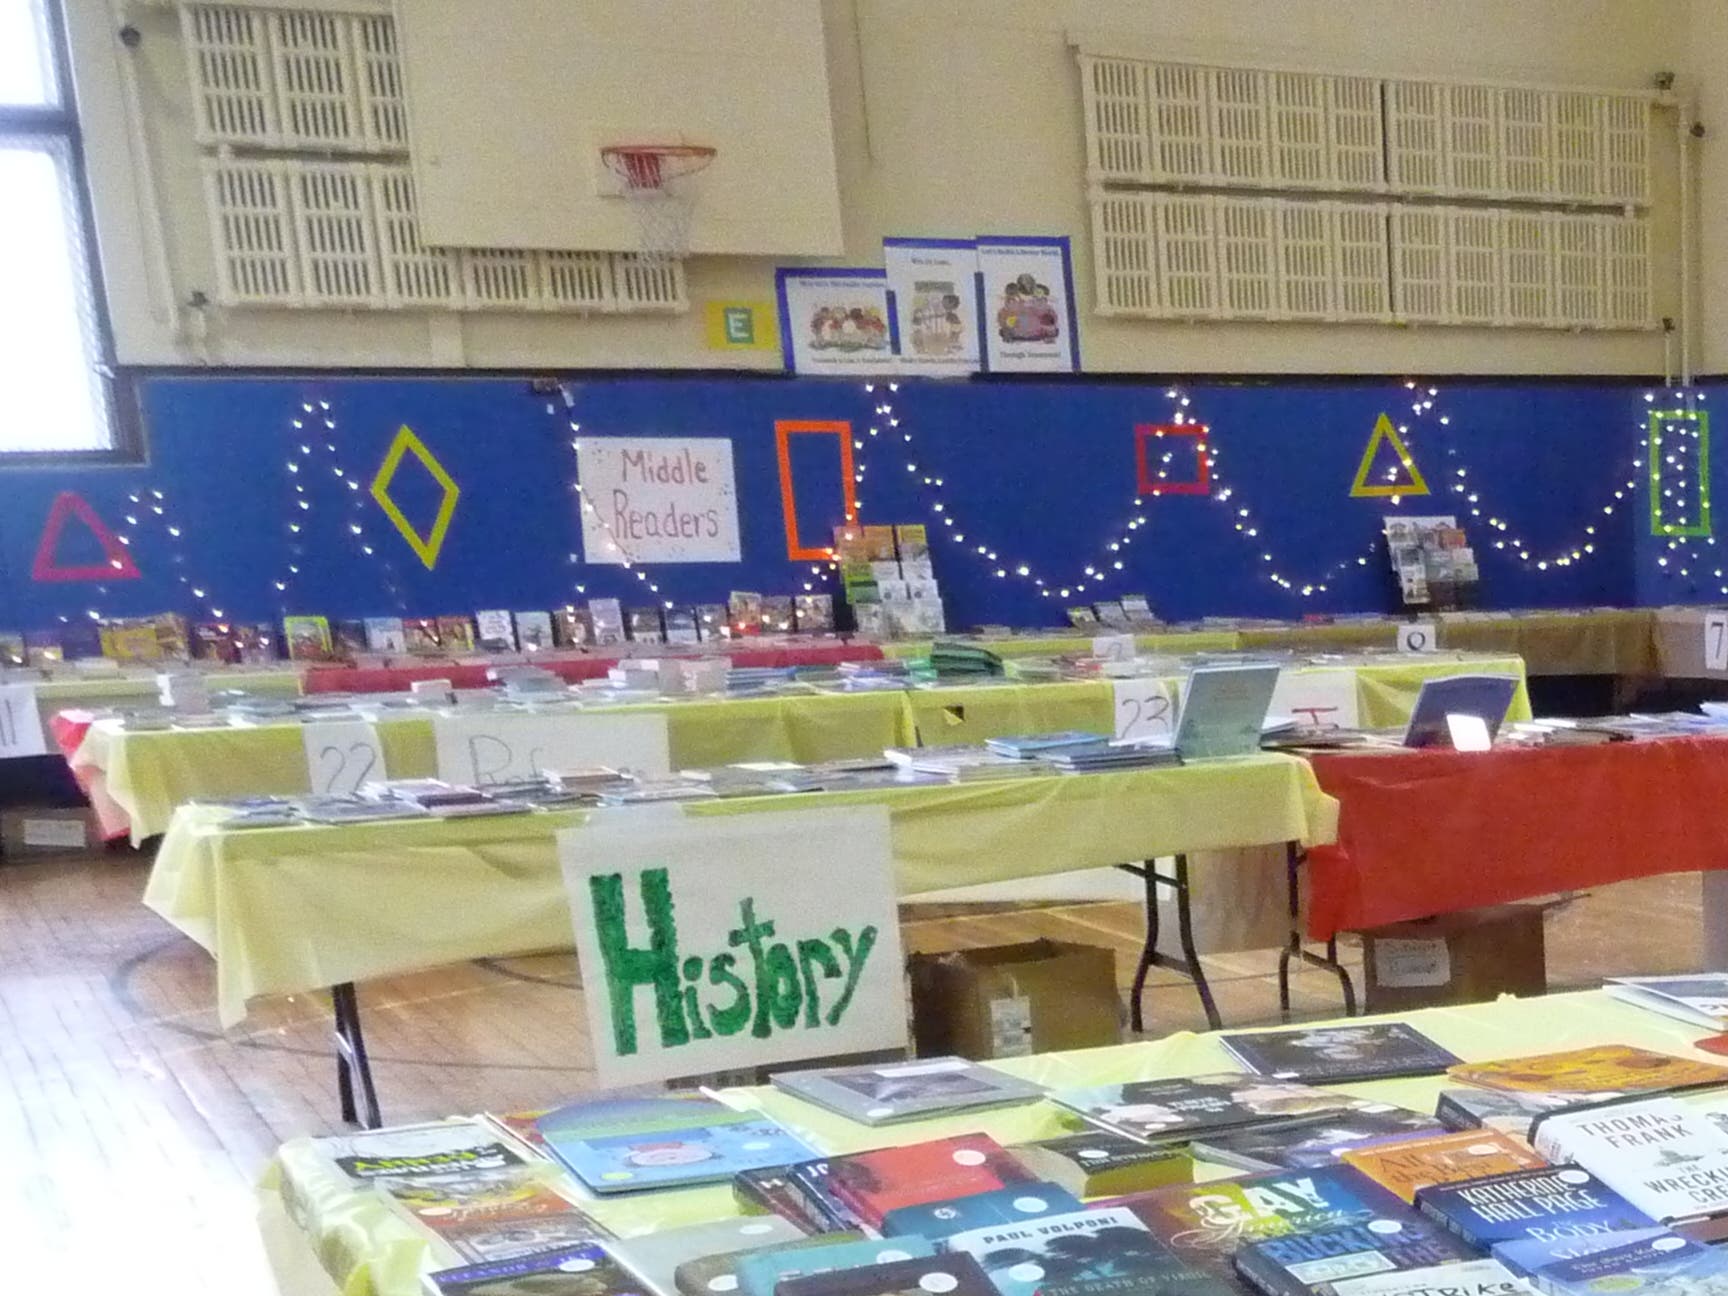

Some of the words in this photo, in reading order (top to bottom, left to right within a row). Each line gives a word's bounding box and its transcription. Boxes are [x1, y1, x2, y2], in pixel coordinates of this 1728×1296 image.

[729, 312, 749, 340] E
[621, 448, 708, 485] Middle
[613, 489, 719, 539] Readers
[1710, 620, 1727, 660] 7
[589, 866, 878, 1057] History
[1606, 1123, 1694, 1149] FRANK
[1189, 1176, 1329, 1222] GAY
[1471, 1203, 1544, 1224] HALL
[1541, 1187, 1607, 1214] PAGE
[983, 1230, 1032, 1244] PAUL
[1037, 1216, 1119, 1236] VOLPONI
